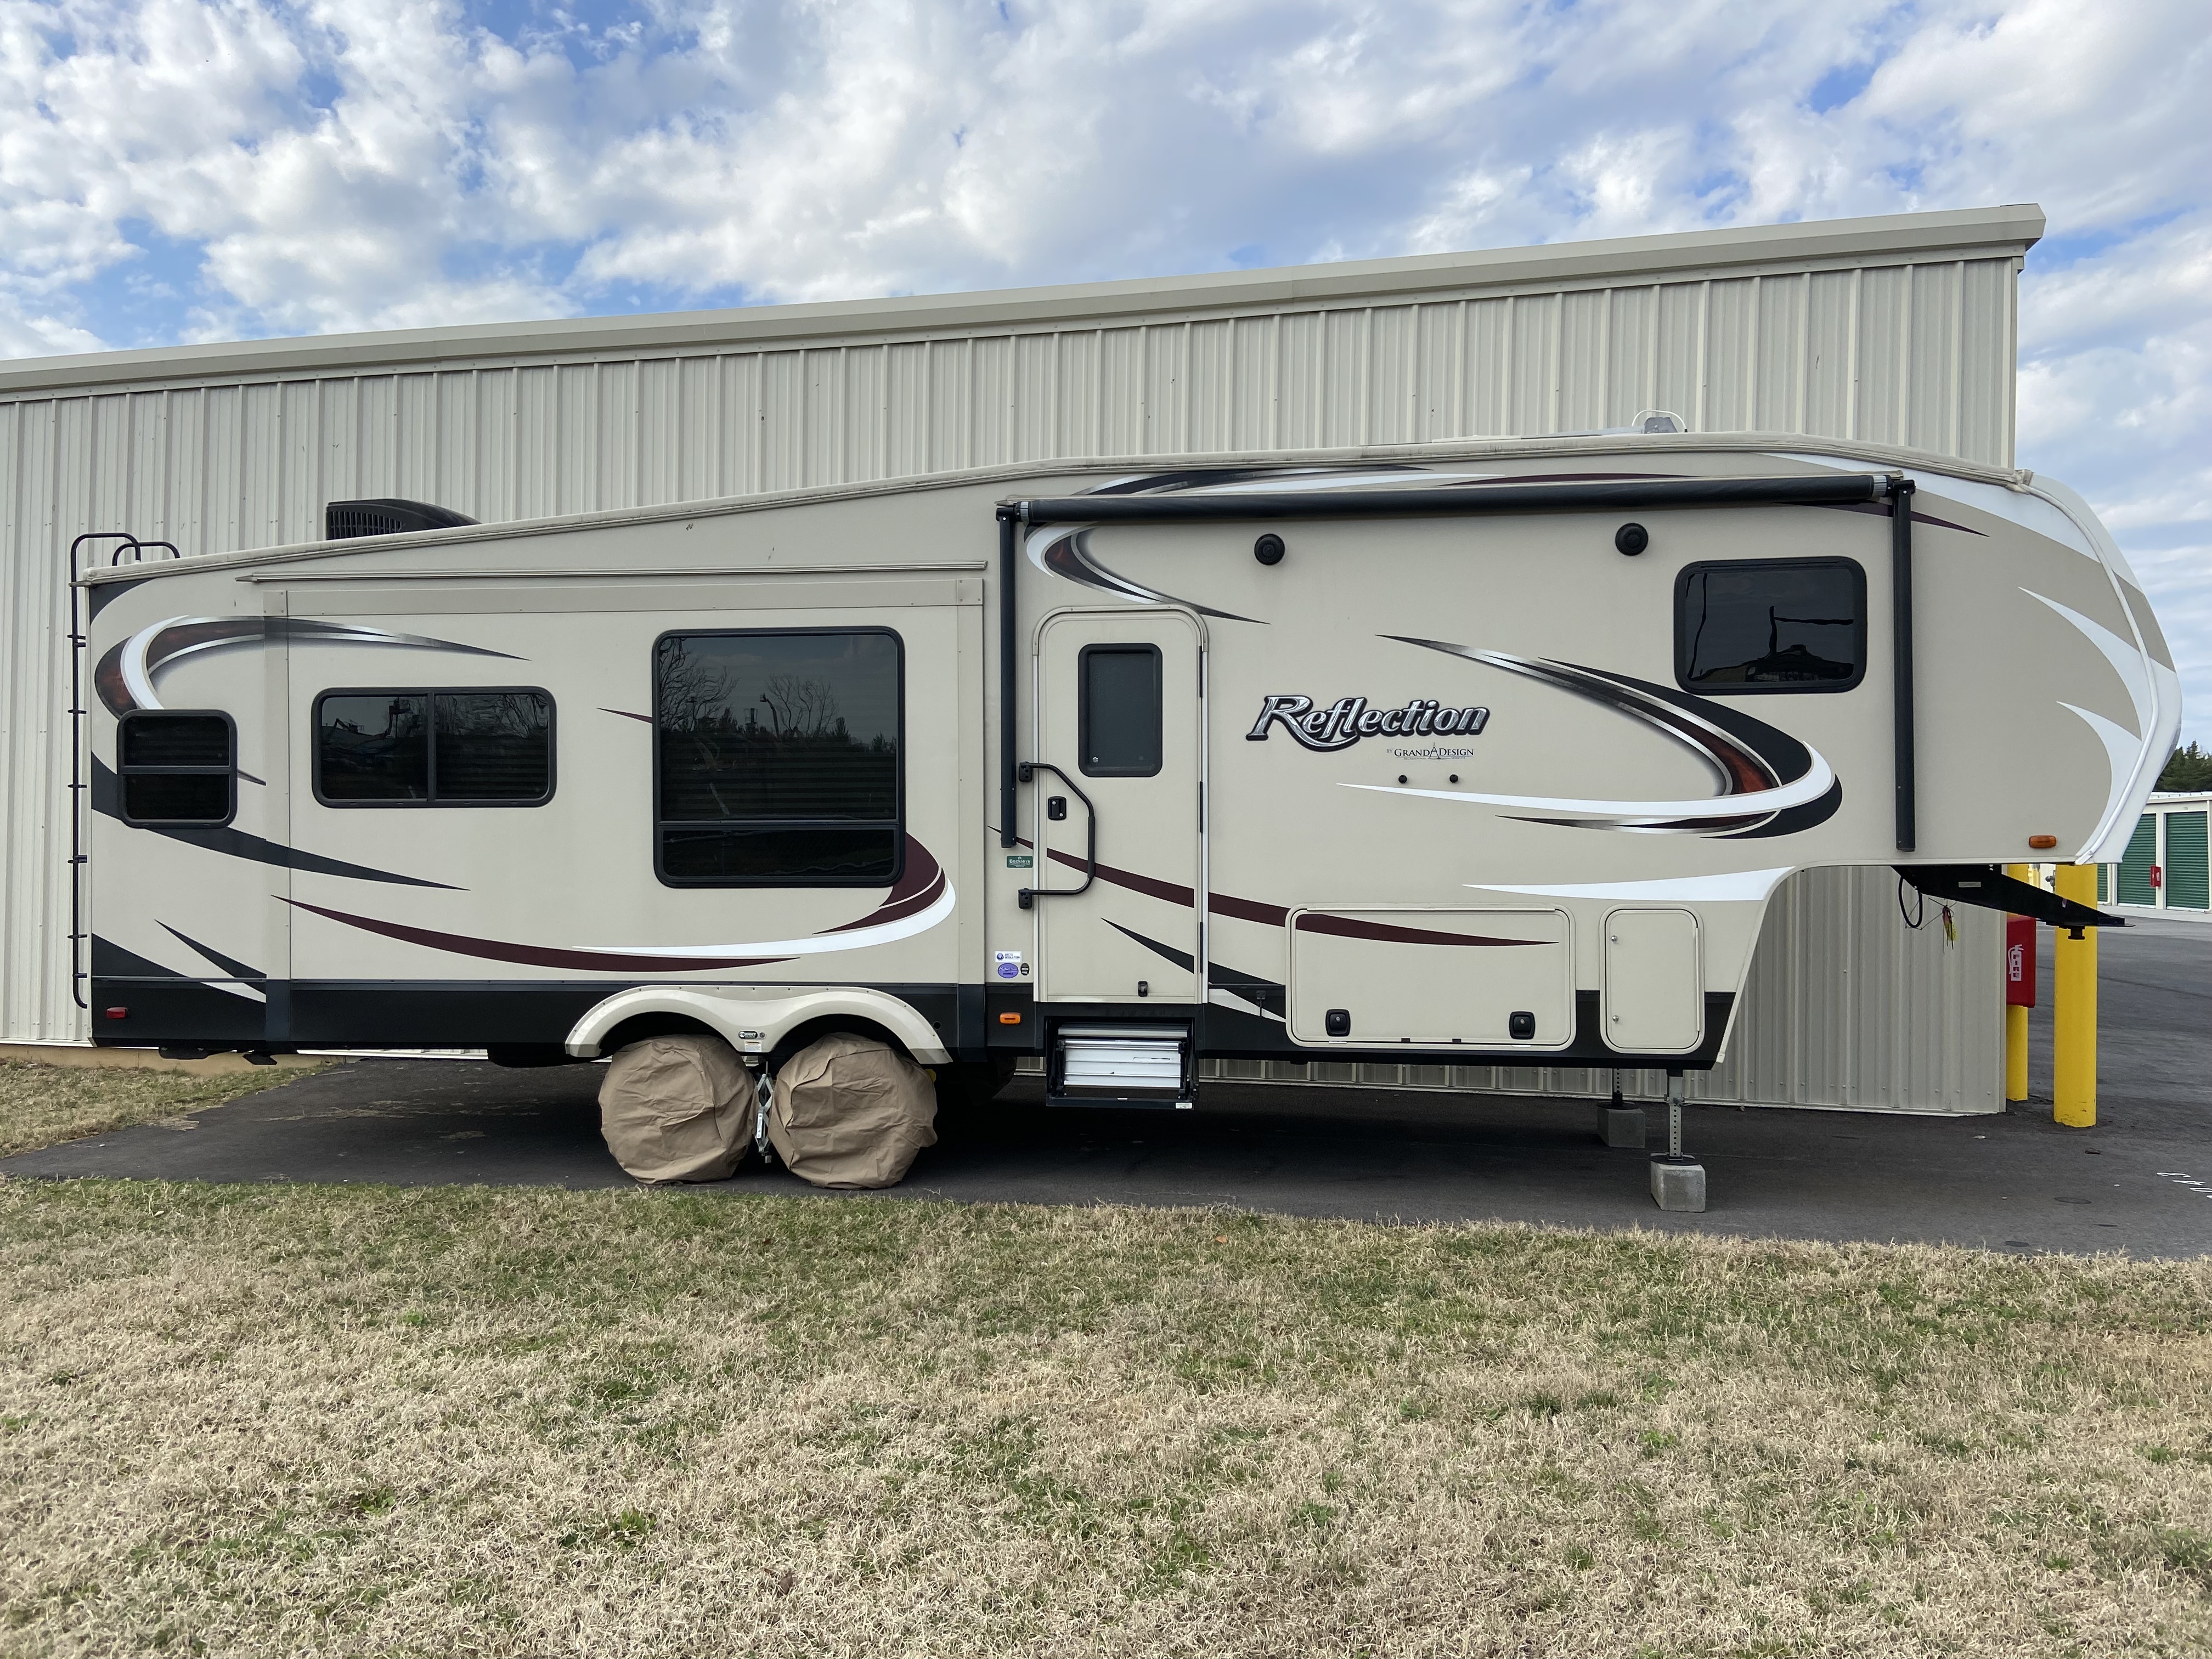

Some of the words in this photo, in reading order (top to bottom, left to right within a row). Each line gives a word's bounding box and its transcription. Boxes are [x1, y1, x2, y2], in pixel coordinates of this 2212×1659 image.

[1245, 695, 1490, 752] Reflection
[1394, 748, 1430, 757] GRAND
[1439, 748, 1474, 756] DESIGN
